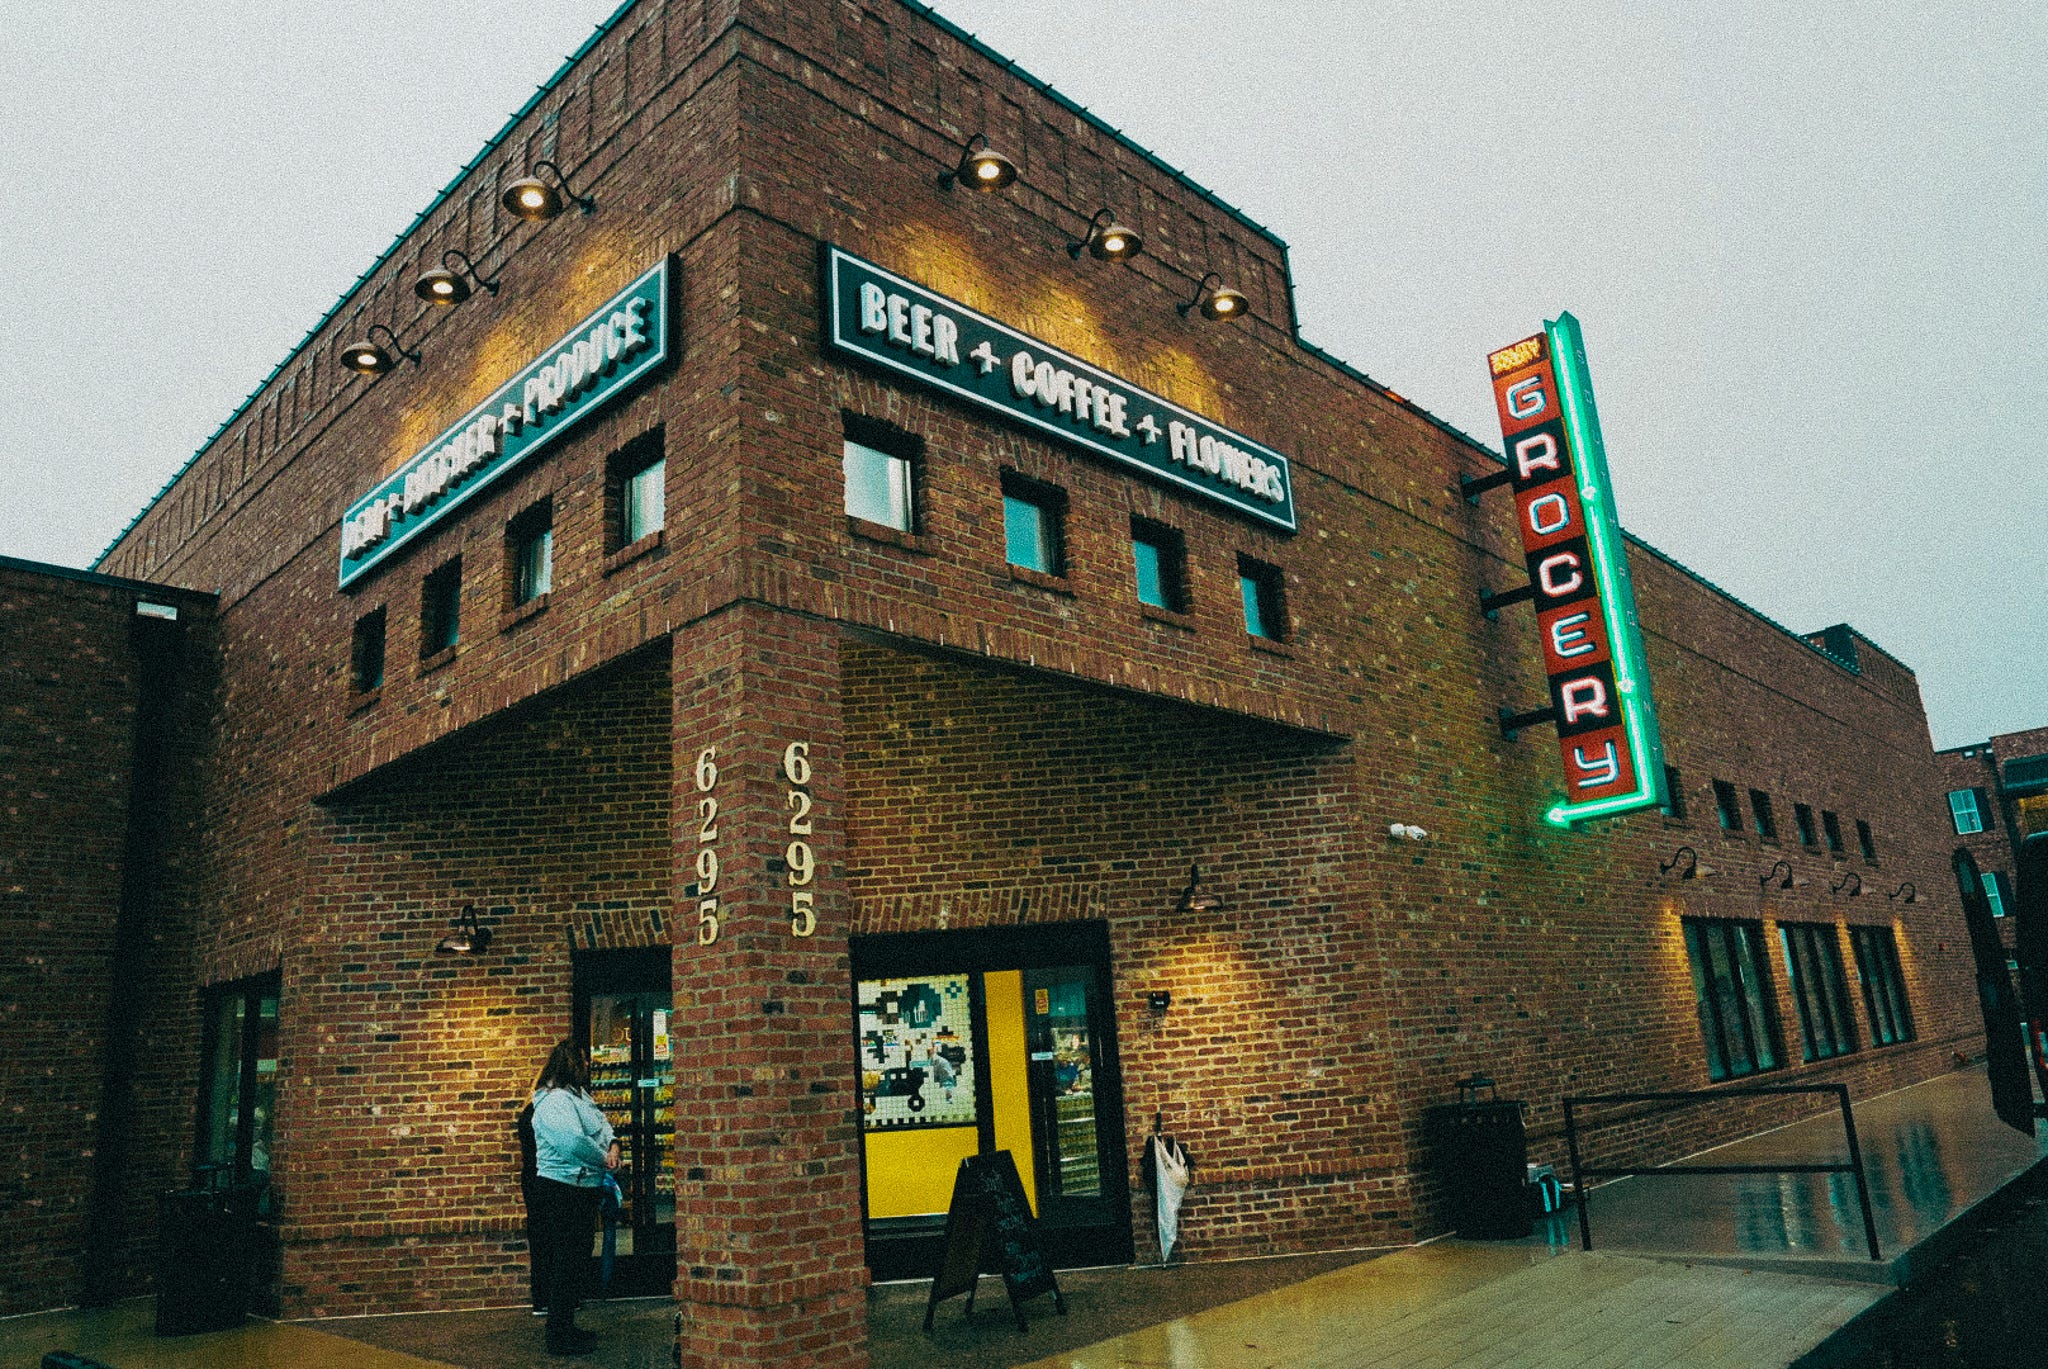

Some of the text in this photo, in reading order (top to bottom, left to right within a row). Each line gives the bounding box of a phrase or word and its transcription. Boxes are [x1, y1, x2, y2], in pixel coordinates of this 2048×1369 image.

[402, 414, 498, 514] BUTCHER
[523, 296, 646, 425] PRODUCE
[859, 281, 960, 367] BEER
[1011, 351, 1131, 438] COFFEE
[1168, 419, 1285, 502] FLOWERS
[1505, 374, 1621, 790] GROCERY
[695, 745, 720, 946] 62295
[784, 741, 817, 939] 62295
